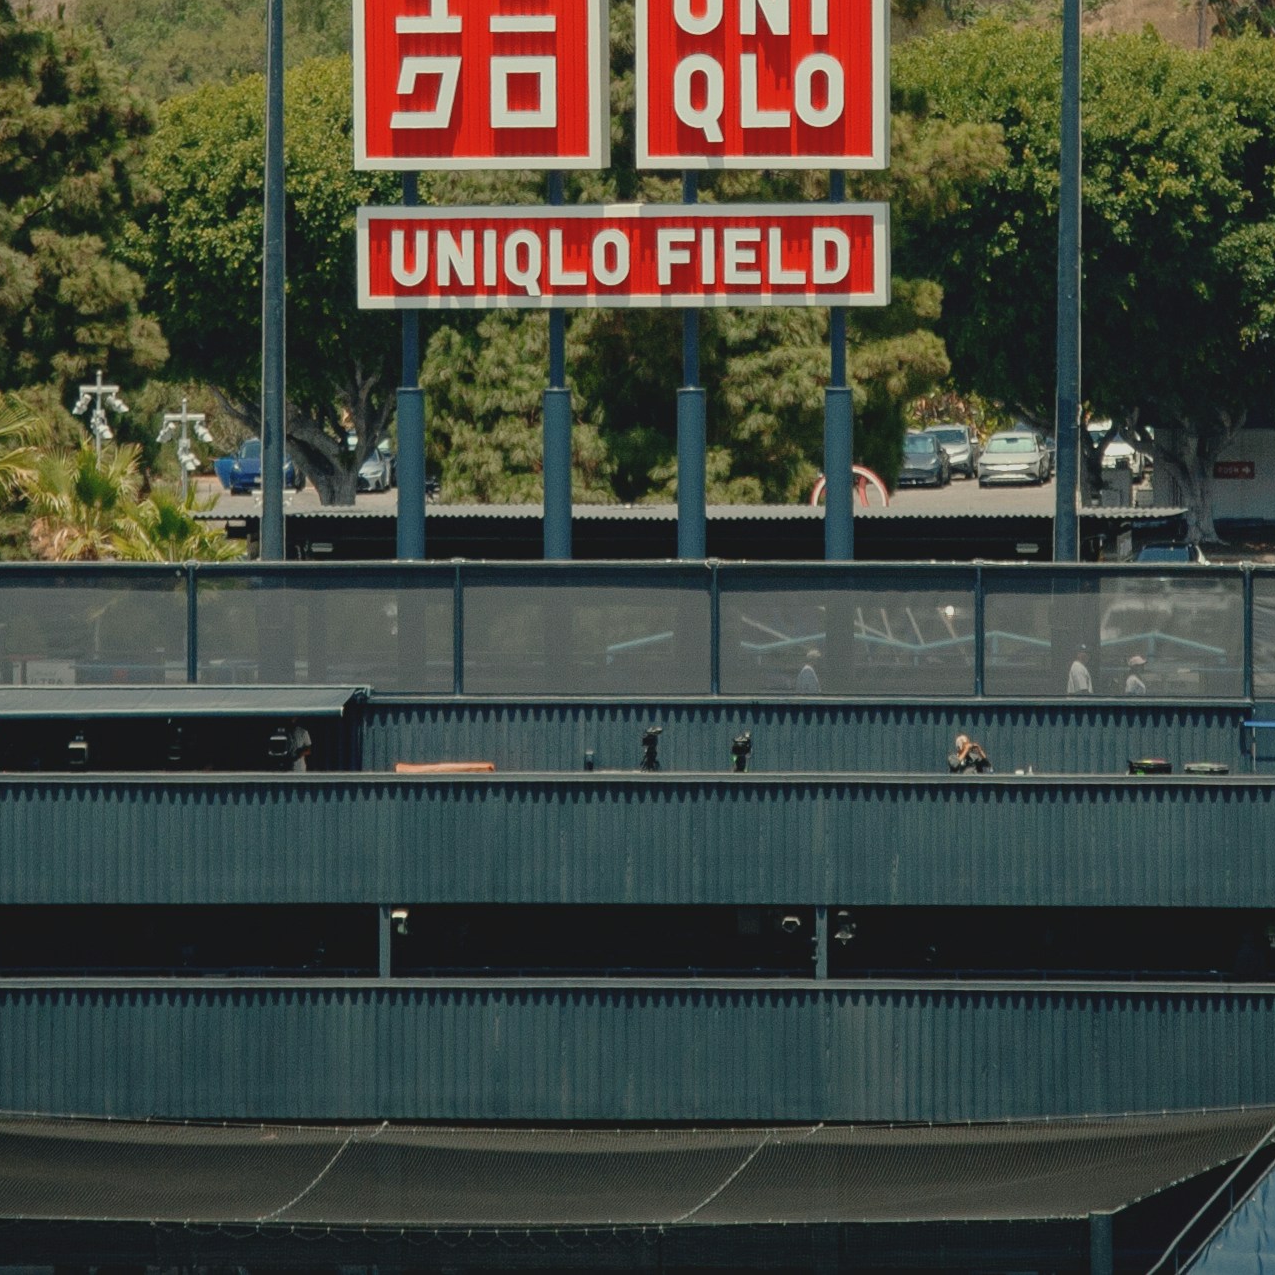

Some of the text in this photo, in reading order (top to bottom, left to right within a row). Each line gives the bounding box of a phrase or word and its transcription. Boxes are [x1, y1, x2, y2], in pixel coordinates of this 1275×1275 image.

[390, 55, 557, 129] クロ
[672, 53, 846, 142] QLO
[390, 226, 851, 297] UNIQLO FIELD
